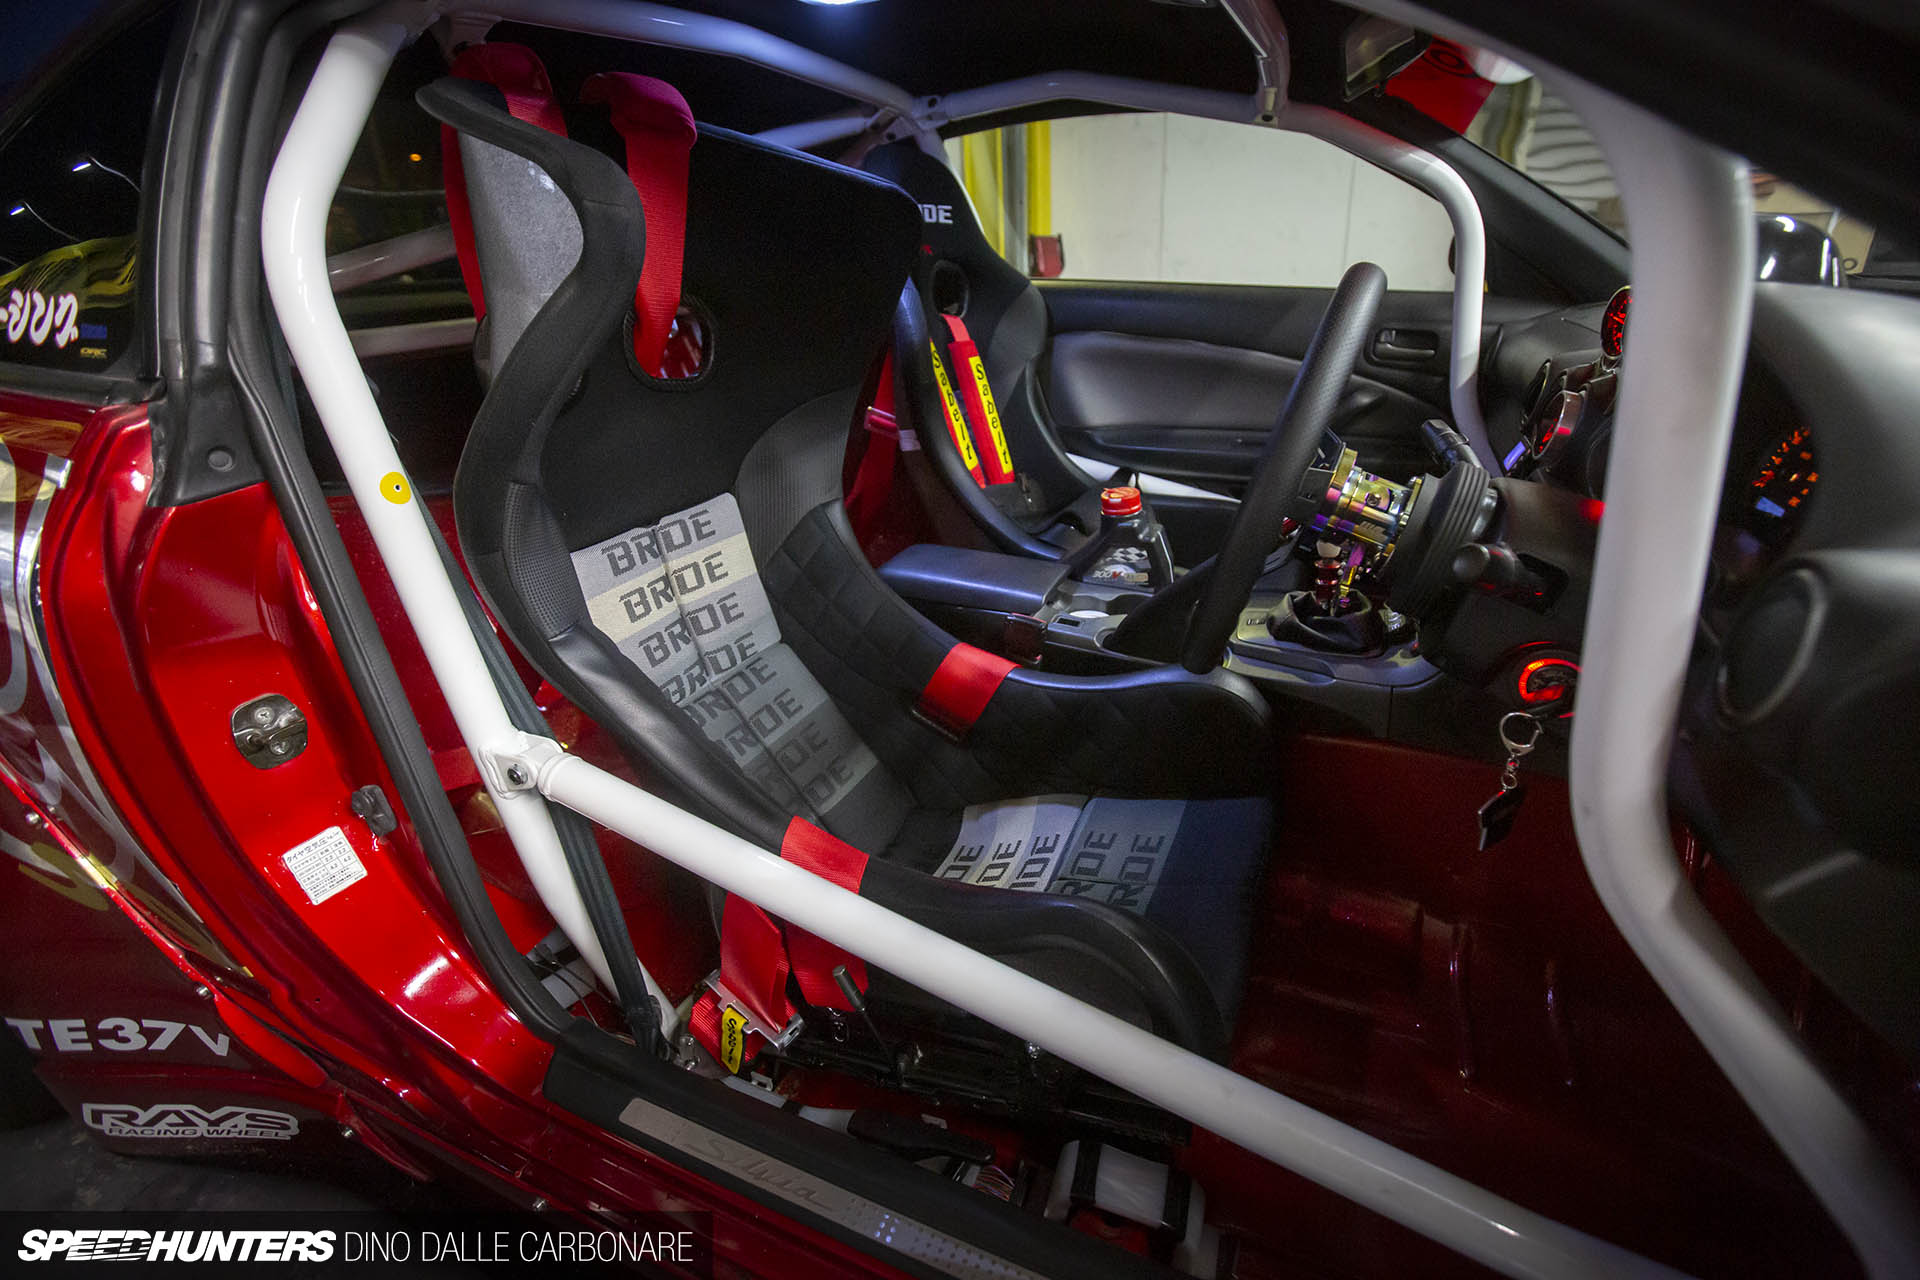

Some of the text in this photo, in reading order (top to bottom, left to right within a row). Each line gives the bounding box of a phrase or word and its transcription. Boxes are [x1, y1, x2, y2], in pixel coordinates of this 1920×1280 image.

[975, 363, 1009, 465] Sabelt
[84, 1103, 298, 1131] RAYS
[108, 1127, 288, 1138] RACING WHEEL
